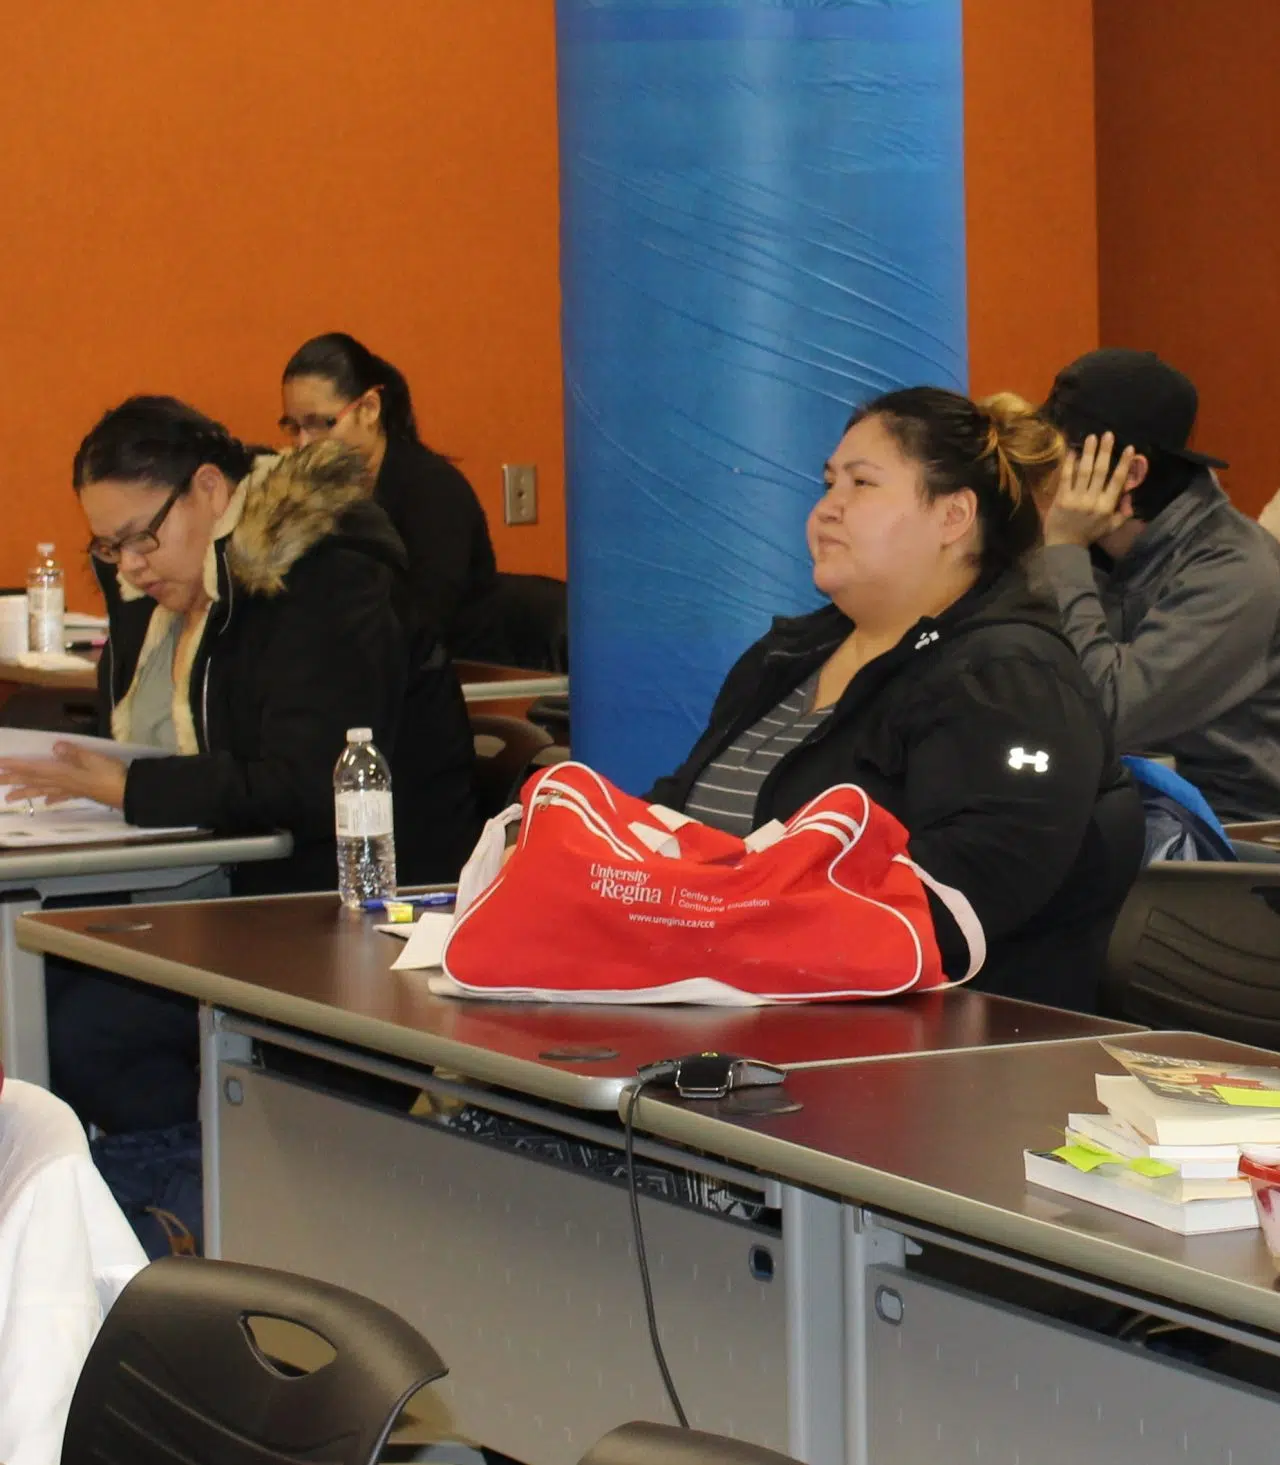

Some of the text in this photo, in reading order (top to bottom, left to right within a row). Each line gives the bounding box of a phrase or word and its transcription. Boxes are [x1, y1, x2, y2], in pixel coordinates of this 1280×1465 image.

[590, 863, 651, 885] University
[591, 878, 662, 905] of Regina
[680, 887, 724, 905] Centre for
[628, 913, 715, 928] www.uregina.ca/cce
